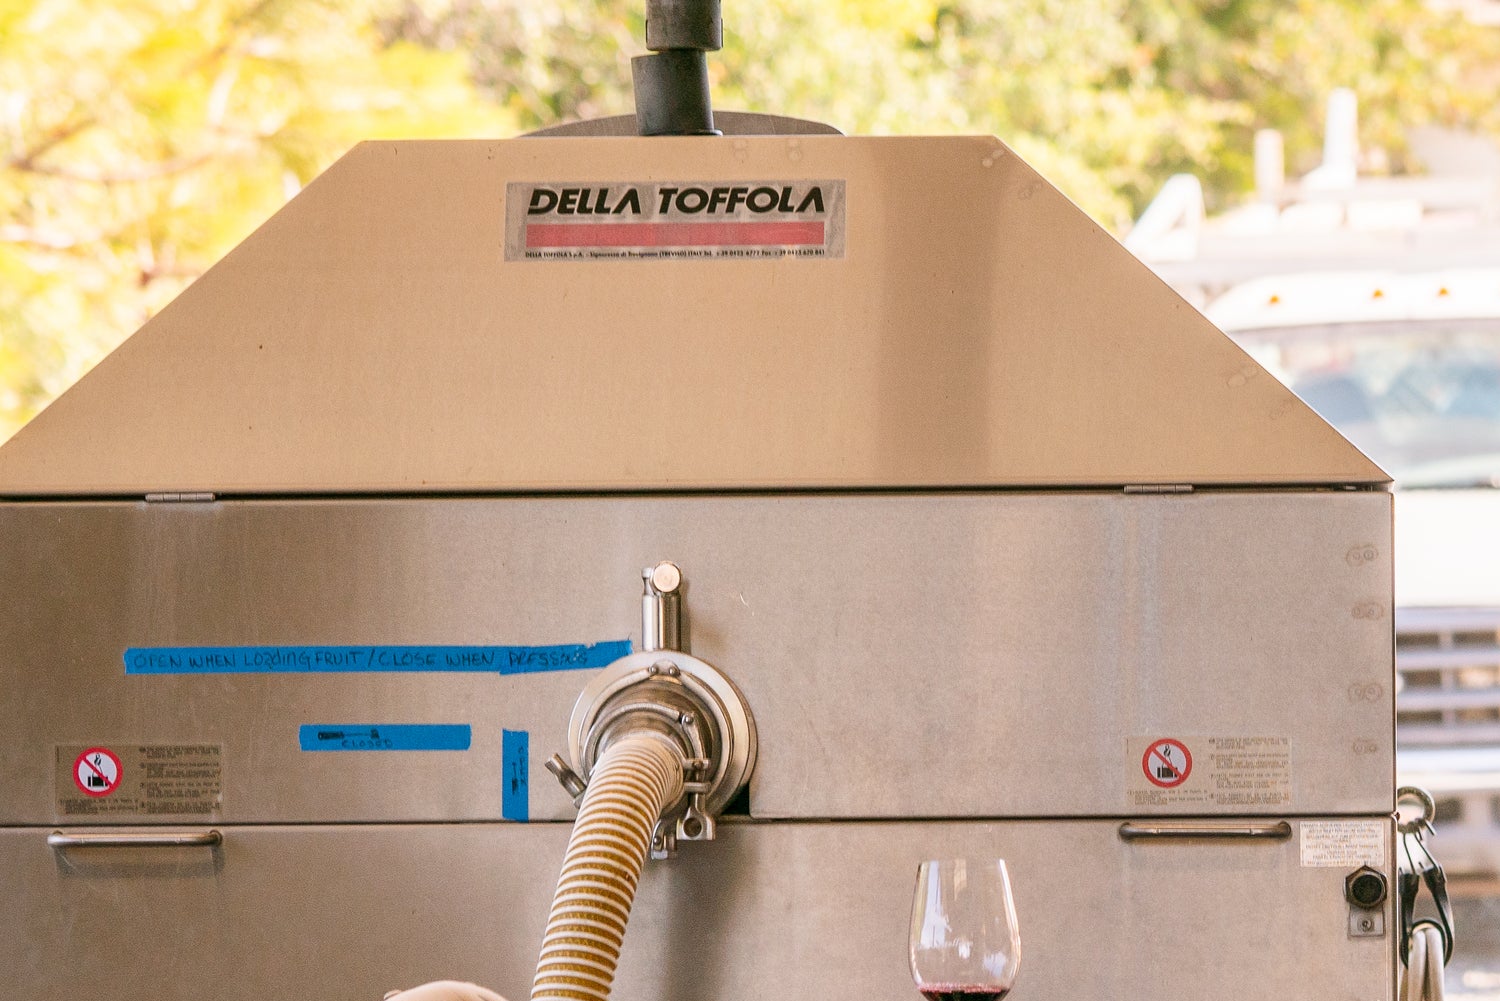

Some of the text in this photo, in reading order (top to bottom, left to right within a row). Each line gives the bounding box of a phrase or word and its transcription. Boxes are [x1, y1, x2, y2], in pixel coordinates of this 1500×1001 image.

[527, 186, 825, 216] DELLA TOFFOLA
[133, 653, 182, 668] OPEN
[190, 653, 236, 668] WHEN
[315, 651, 365, 665] FRUIT
[446, 651, 495, 667] WHEN
